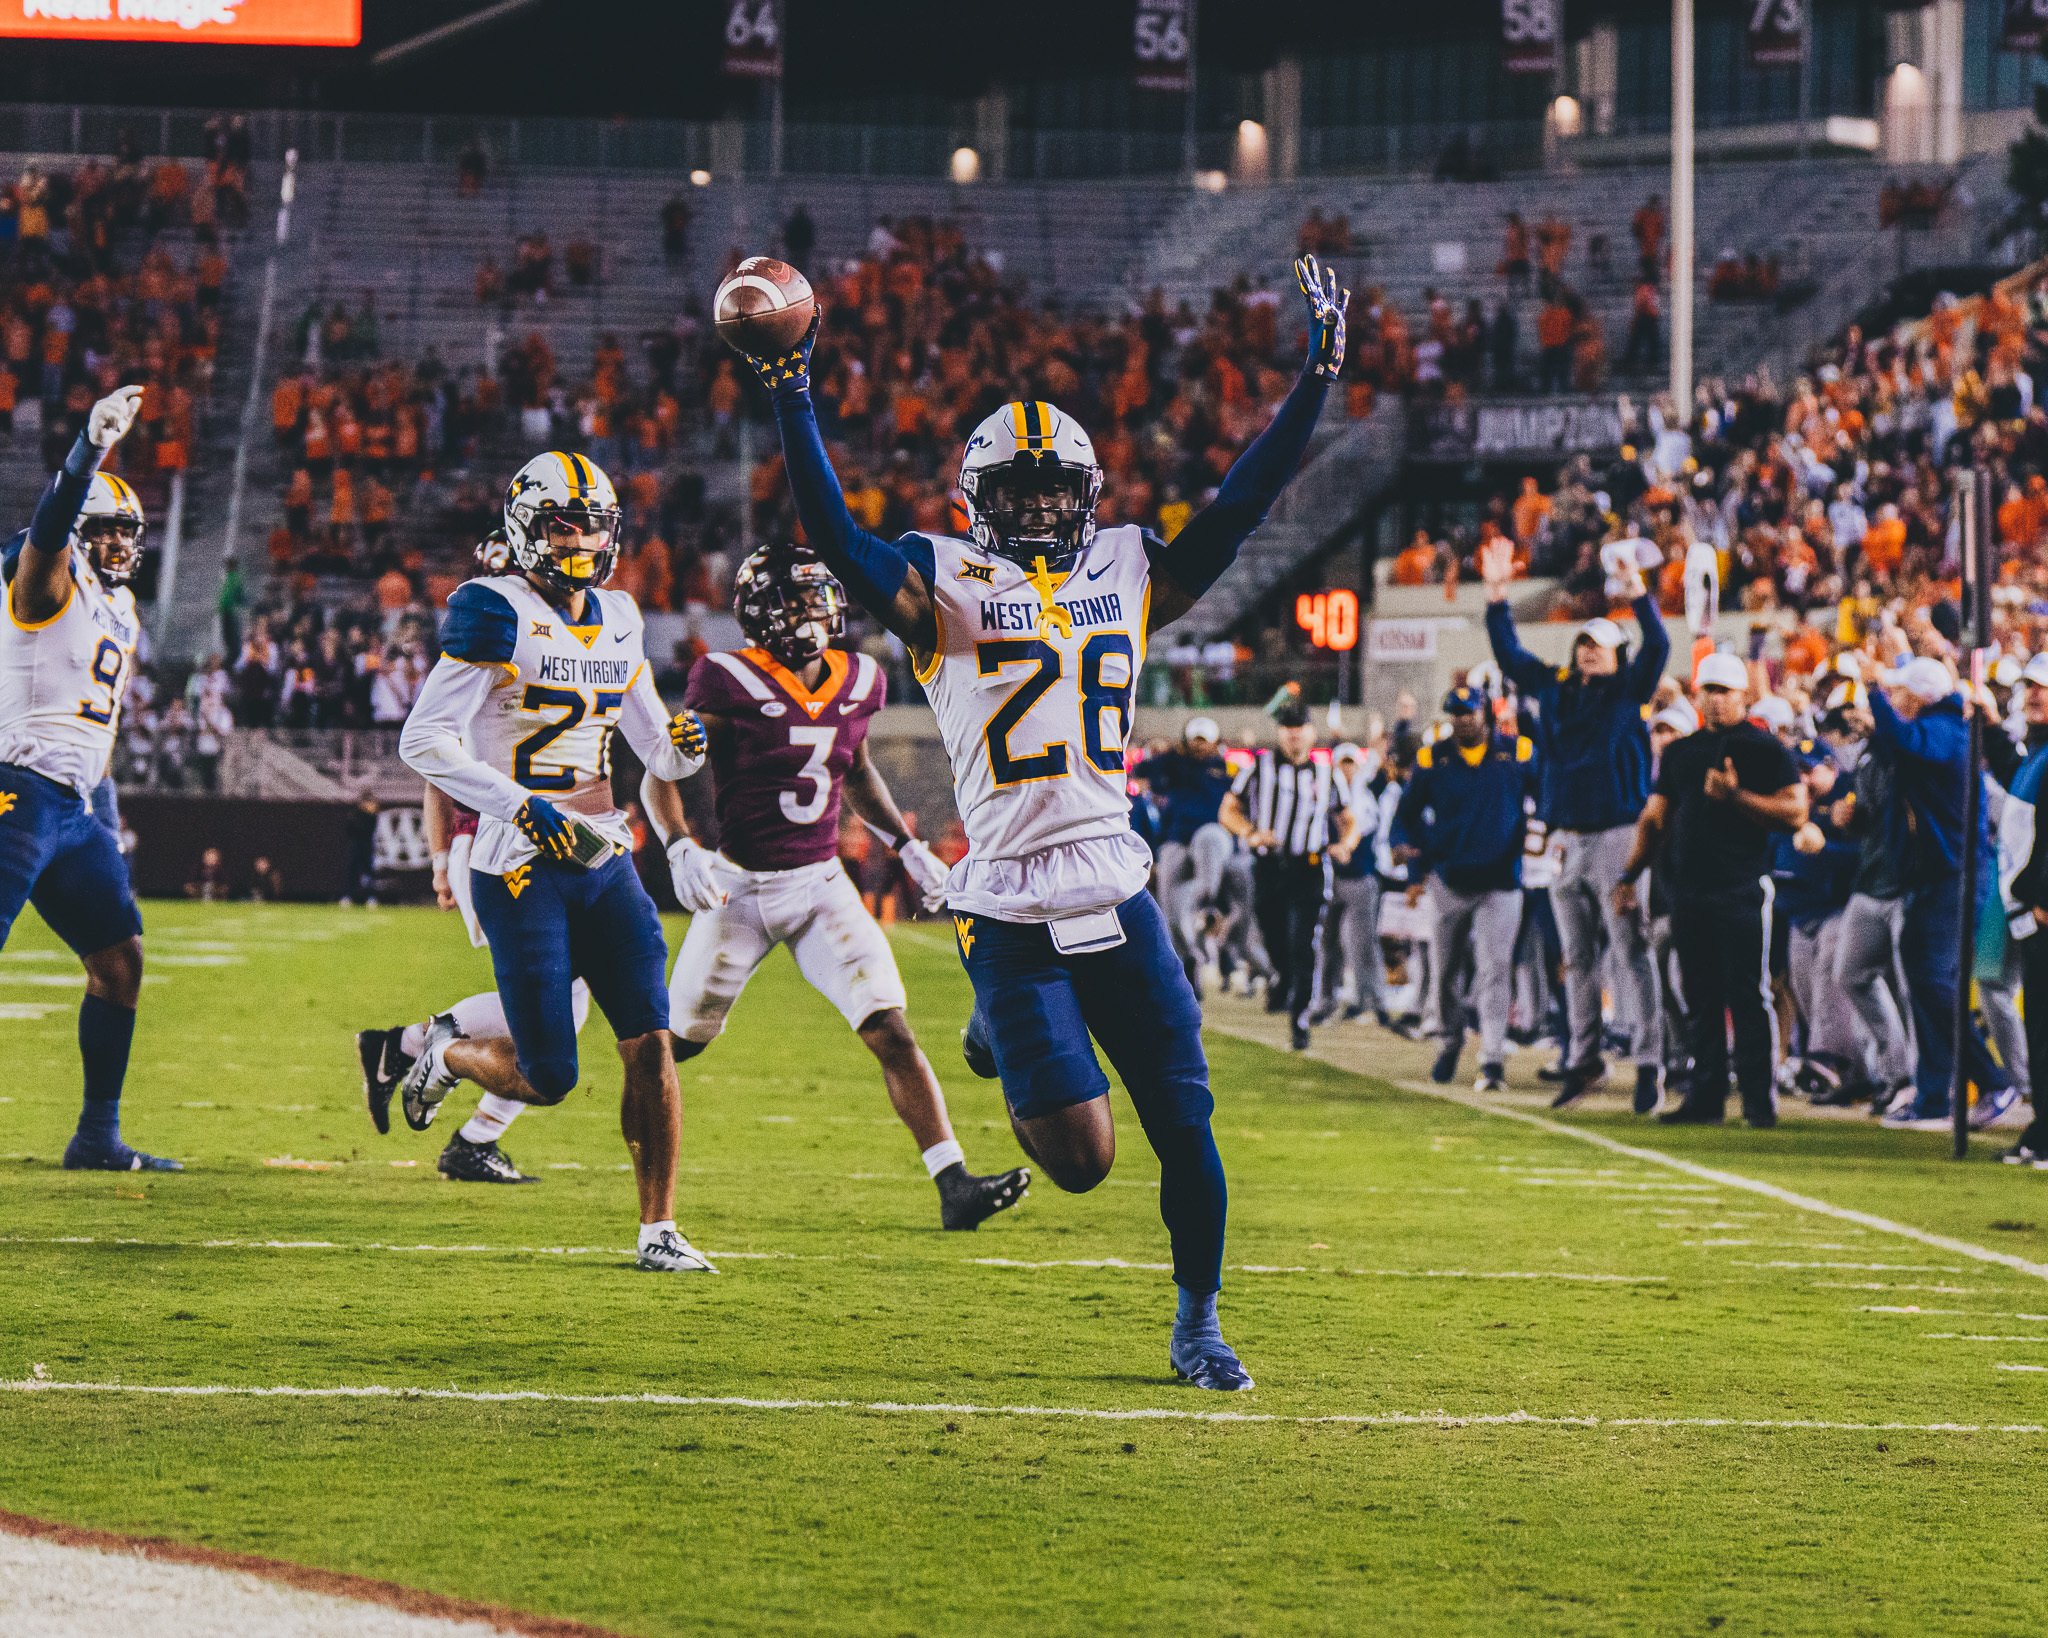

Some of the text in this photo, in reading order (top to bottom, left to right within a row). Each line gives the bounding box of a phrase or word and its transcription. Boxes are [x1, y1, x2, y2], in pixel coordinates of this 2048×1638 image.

[726, 0, 779, 46] 64
[1135, 14, 1189, 60] 56
[981, 592, 1122, 630] WEST GINIA
[1296, 589, 1359, 651] 40
[540, 654, 628, 684] WEST VIRGINIA
[805, 701, 824, 713] VT
[974, 630, 1134, 789] 28
[779, 726, 838, 824] 3
